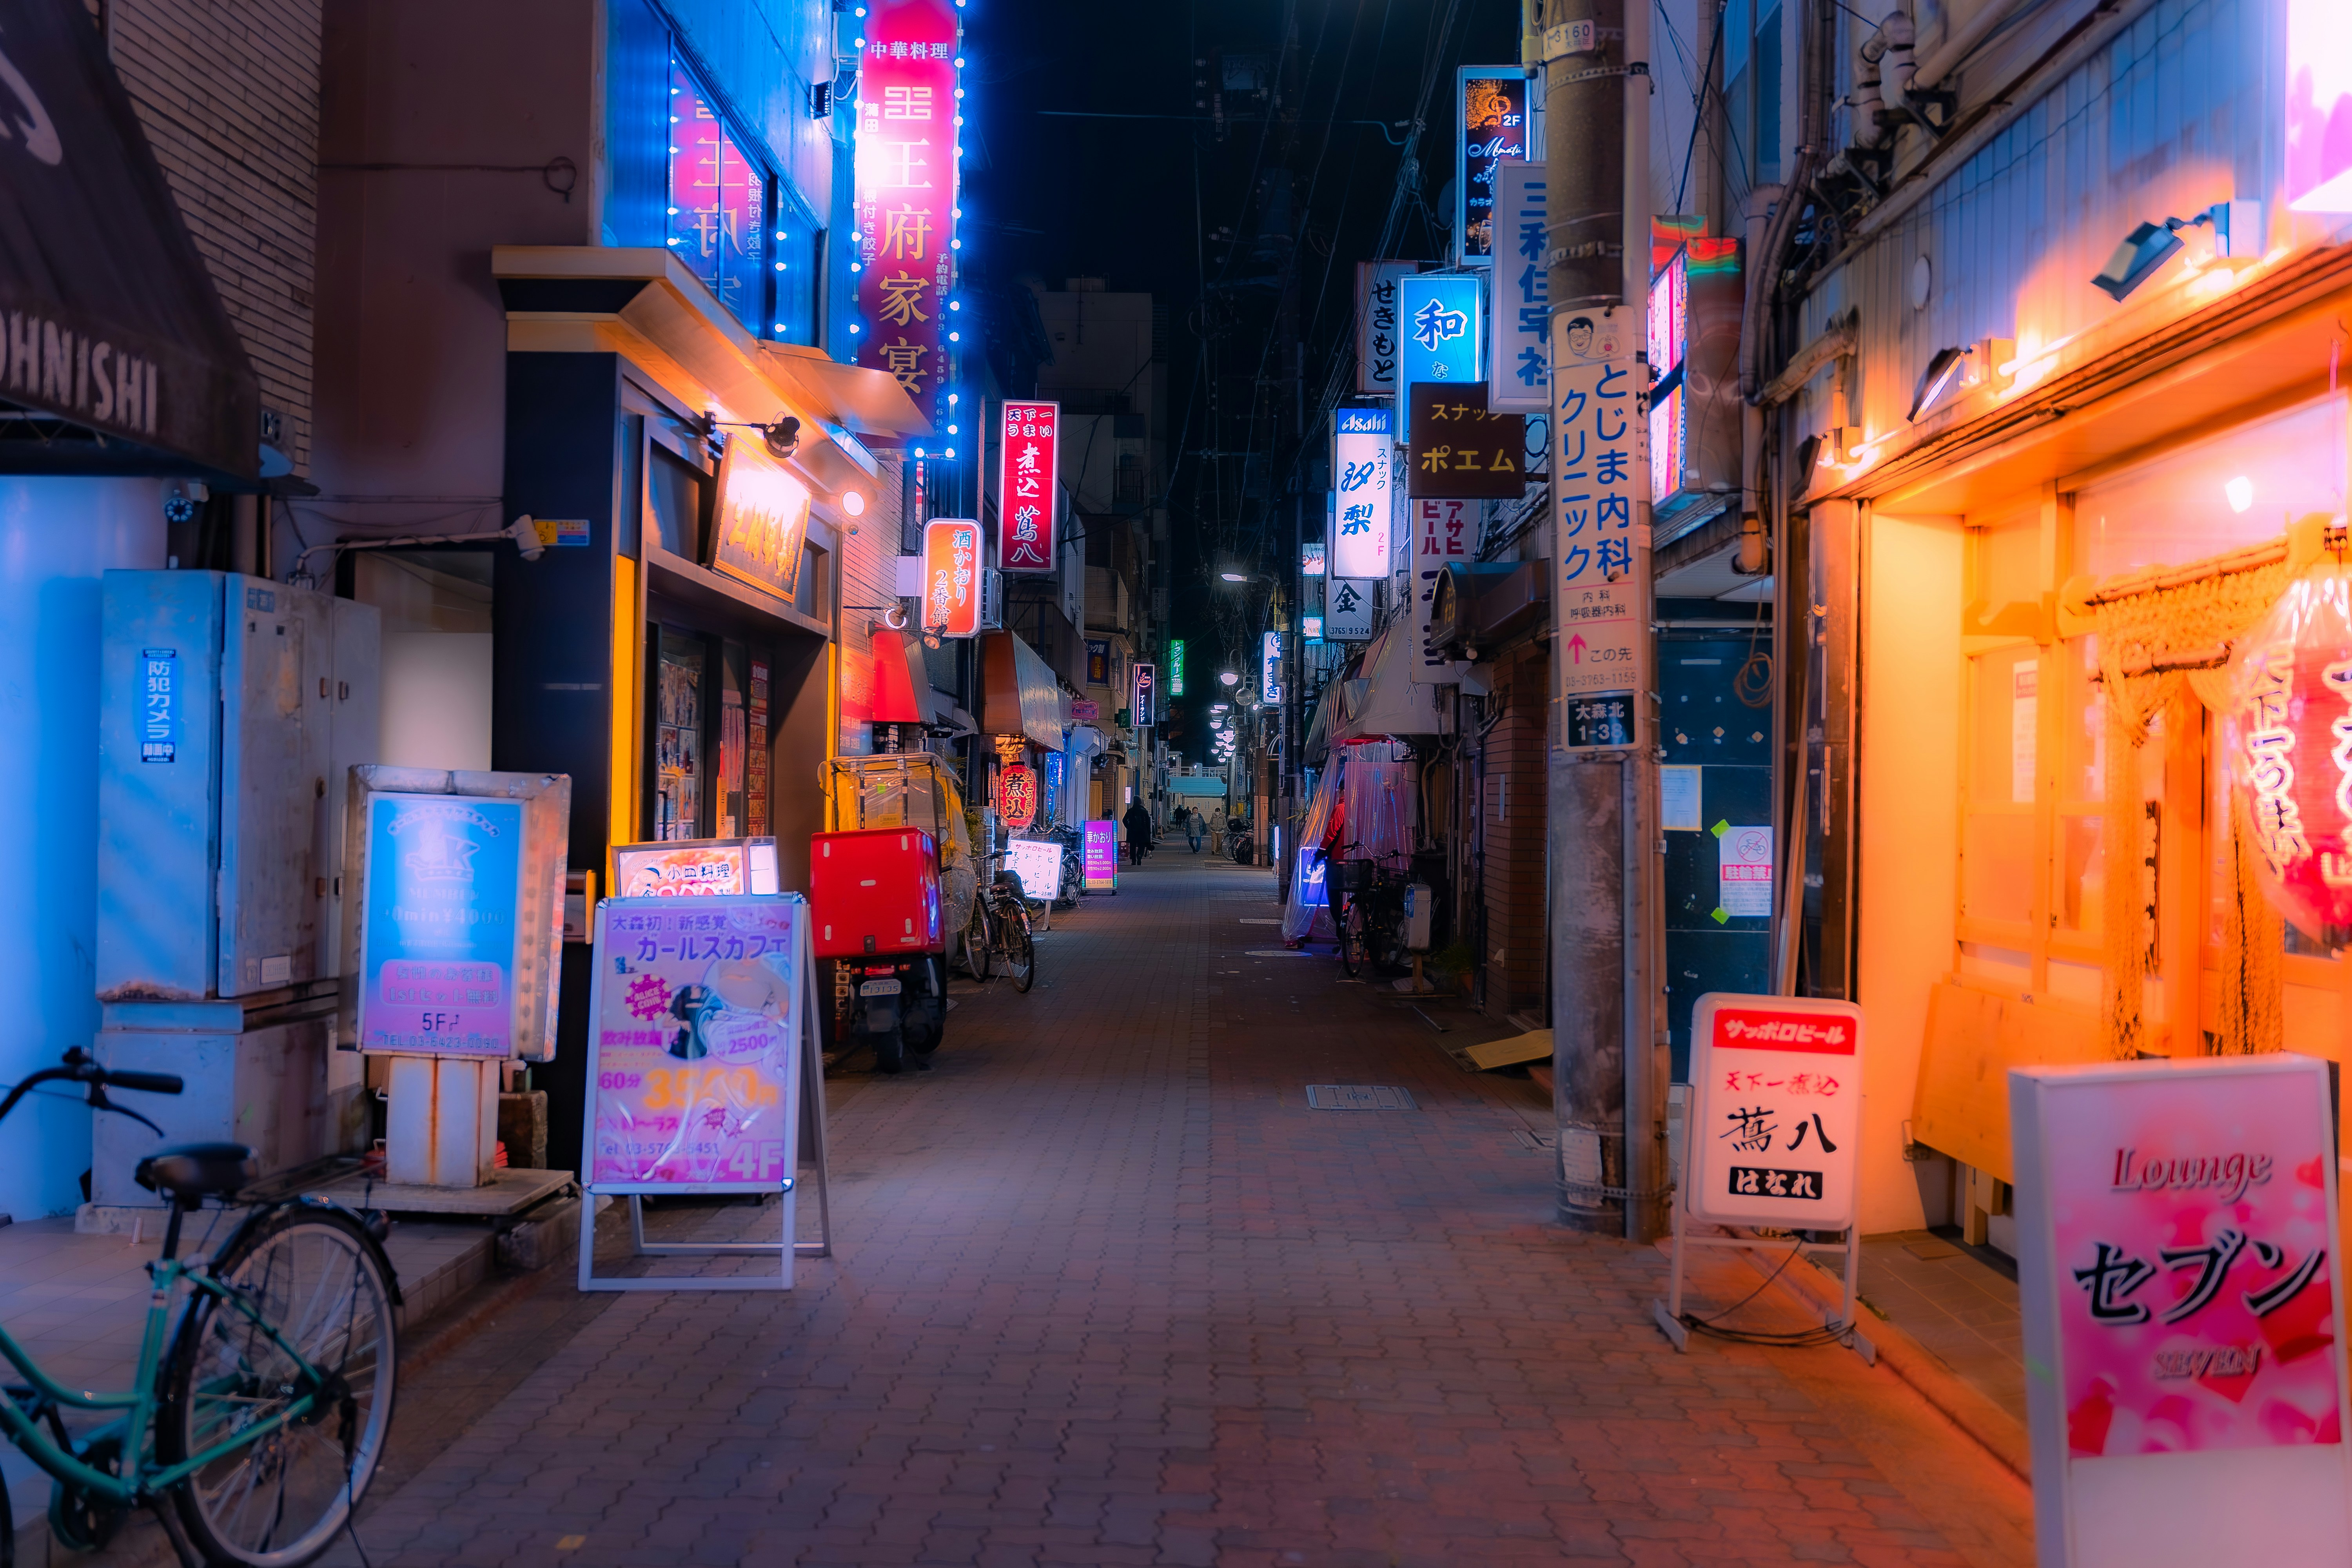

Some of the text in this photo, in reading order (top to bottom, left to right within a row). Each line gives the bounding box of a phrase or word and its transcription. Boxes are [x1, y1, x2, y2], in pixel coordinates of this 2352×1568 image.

[870, 40, 949, 61] 中華料理
[1503, 114, 1521, 127] 2F
[862, 102, 880, 267] 蒲田根付き餃子
[878, 137, 933, 395] 王府家宴
[1371, 279, 1396, 383] せきもと
[1412, 298, 1468, 352] 和
[0, 311, 158, 434] HNISHI
[1431, 361, 1450, 379] な
[1007, 408, 1053, 423] 天下一
[1007, 423, 1053, 437] うまい
[1341, 414, 1387, 432] Asahi
[1016, 442, 1041, 498] 煮込
[1376, 448, 1387, 490] スナック
[1421, 445, 1515, 473] ポエム
[1595, 364, 1633, 575] とじま内科
[1341, 461, 1374, 536] 汐梨
[1561, 389, 1591, 581] クリニック
[1377, 532, 1385, 557] 2F
[1421, 501, 1441, 555] ビール
[1446, 501, 1464, 555] アサヒ
[951, 529, 973, 608] 酒かおり
[929, 569, 953, 626] 2番館
[1570, 603, 1627, 619] 呼吸器内科
[1582, 589, 1611, 604] 内科
[1590, 646, 1633, 663] この先
[146, 660, 173, 740] 防犯カメラ
[1575, 701, 1624, 721] 大森北
[1005, 773, 1025, 820] 煮込
[1087, 831, 1111, 844] 華かおり
[383, 1034, 404, 1047] TEL
[422, 1012, 447, 1031] 5F
[1725, 1020, 1845, 1045] サッポロビール
[1725, 1070, 1840, 1096] 天下一煮込
[729, 1141, 784, 1181] 4F
[2111, 1146, 2272, 1205] Lounge
[1736, 1169, 1817, 1197] はなれ
[2072, 1229, 2327, 1326] セブン
